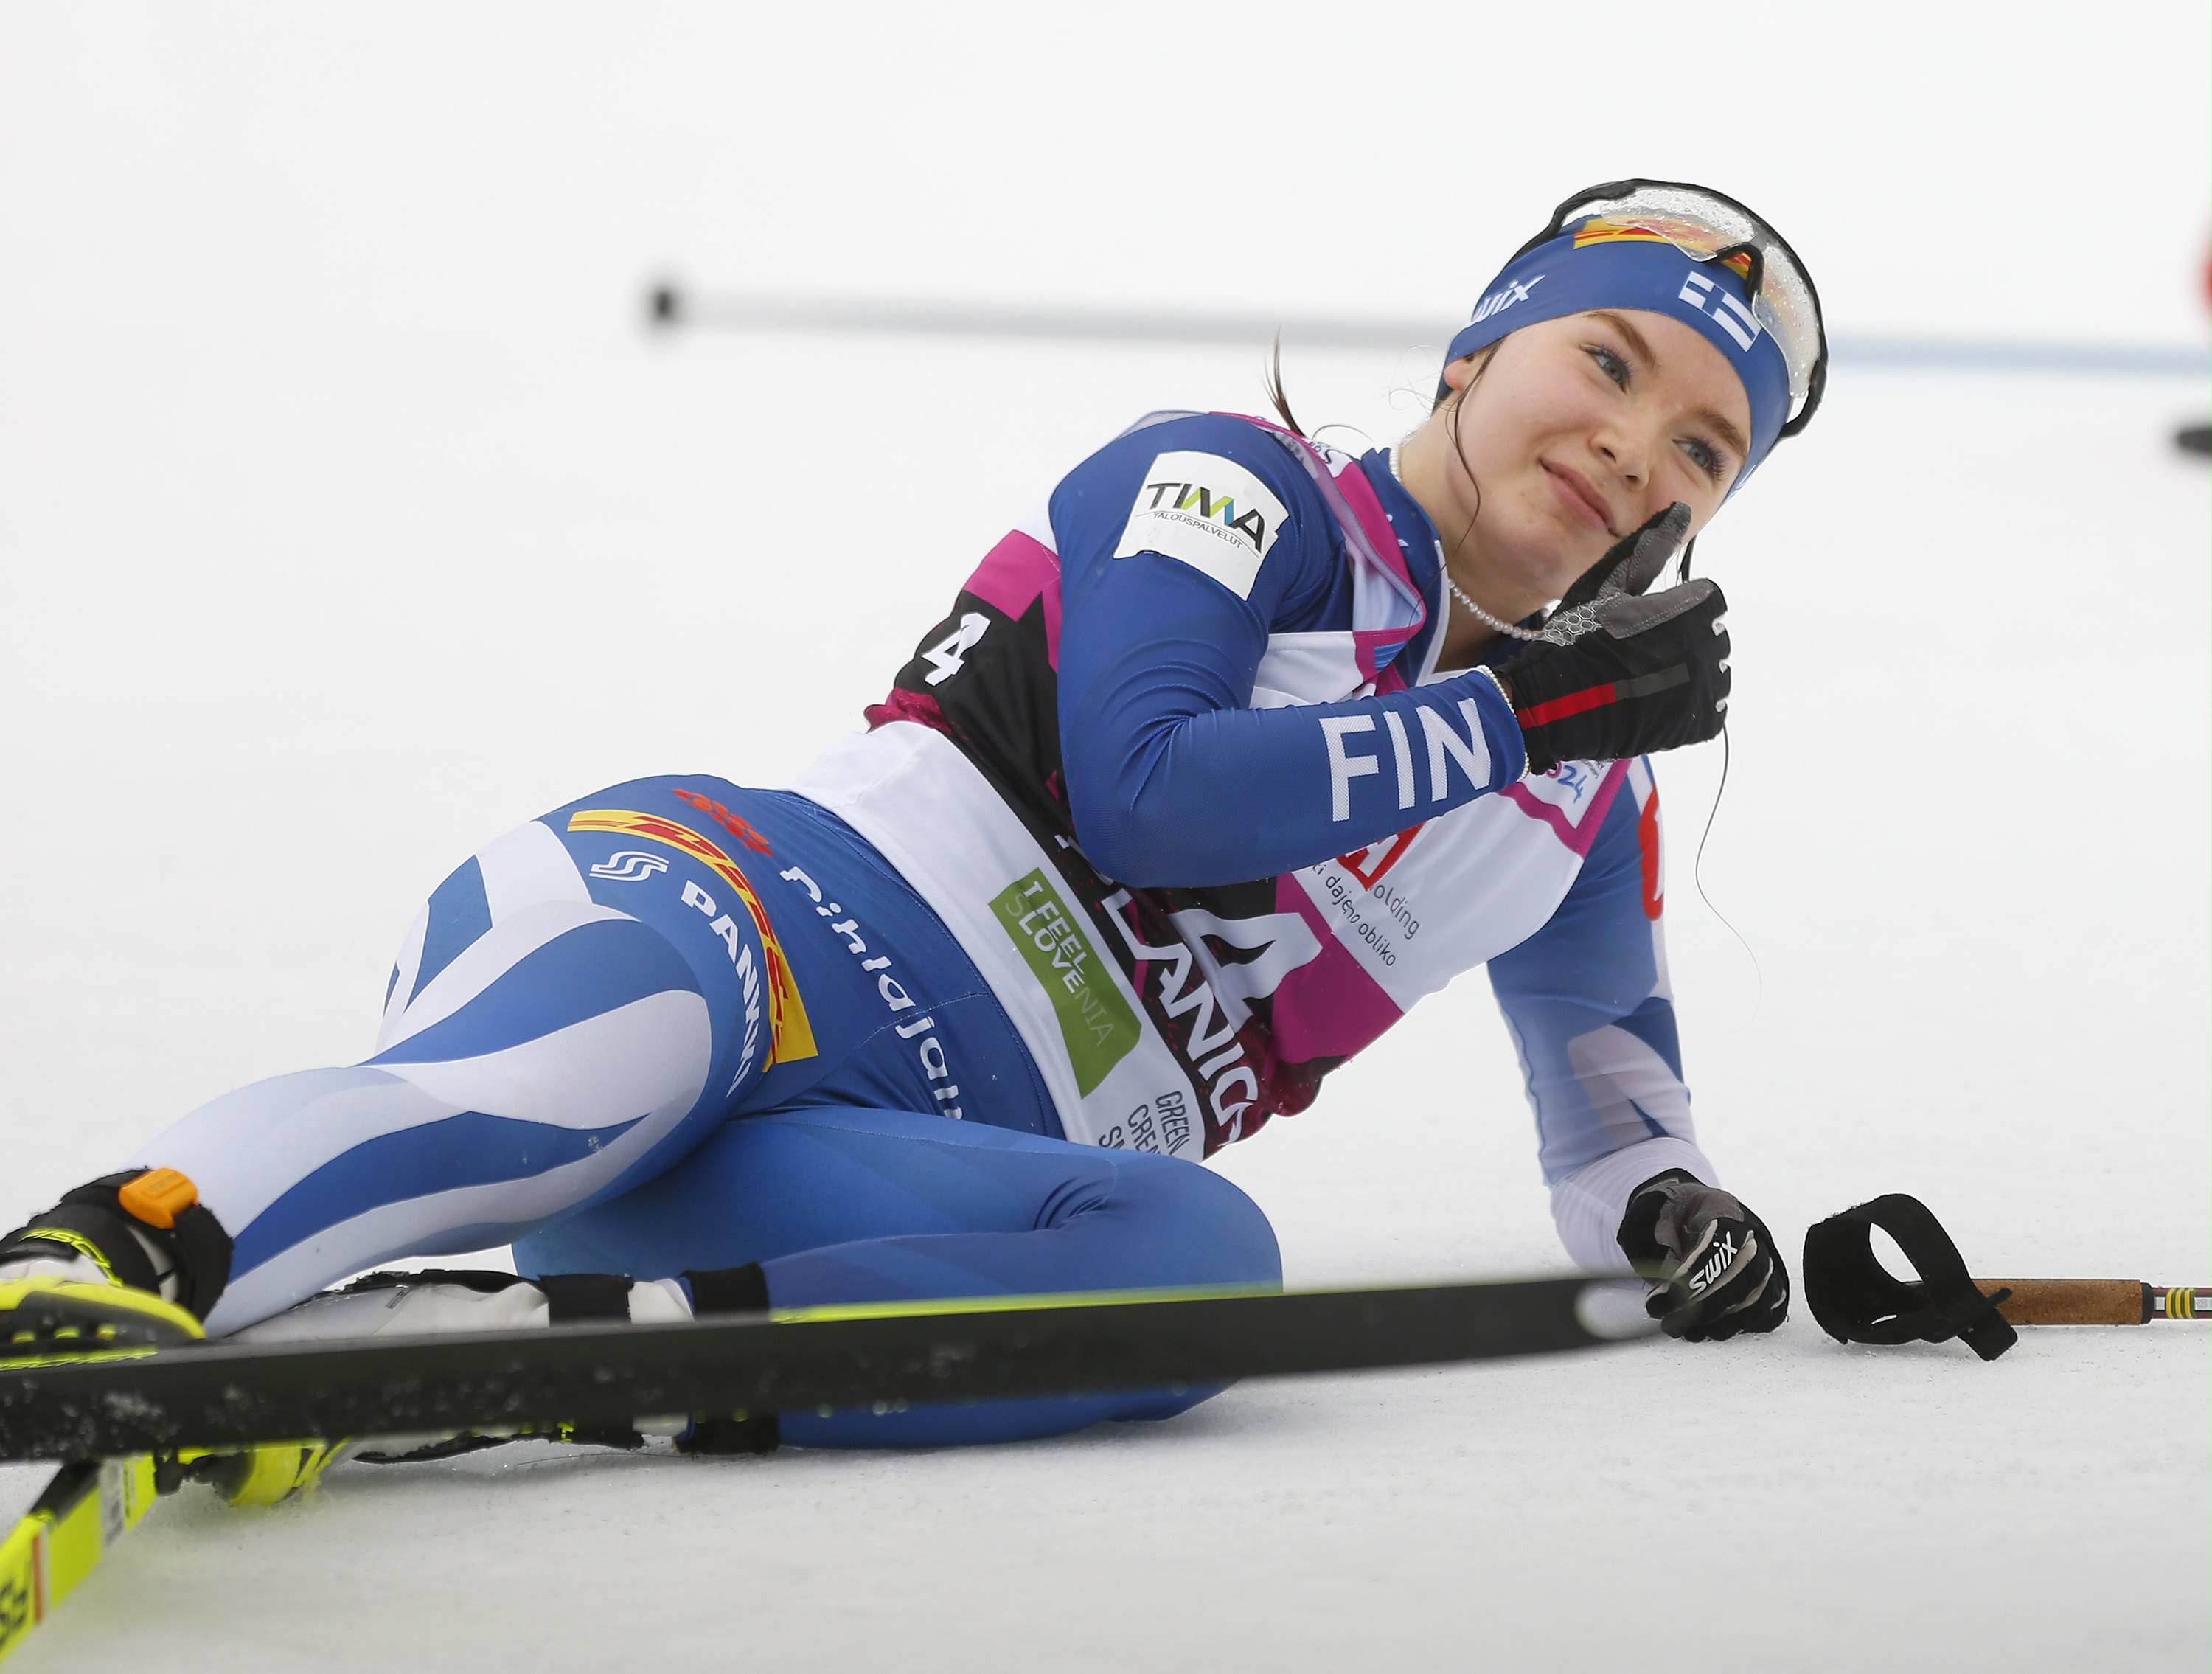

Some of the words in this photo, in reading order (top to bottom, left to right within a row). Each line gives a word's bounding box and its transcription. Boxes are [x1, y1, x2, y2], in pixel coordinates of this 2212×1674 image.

[1464, 274, 1545, 329] wix
[1154, 513, 1243, 549] TALOUSPALVELUT
[922, 612, 991, 687] 4
[1318, 698, 1492, 822] FIN
[1023, 881, 1044, 897] I
[1036, 901, 1088, 975] FEEL
[1358, 923, 1396, 966] obliko
[1370, 885, 1420, 940] olding
[1006, 893, 1115, 1047] SLOVENIA
[1170, 908, 1323, 1033] 4
[1155, 1091, 1190, 1156] GREEN
